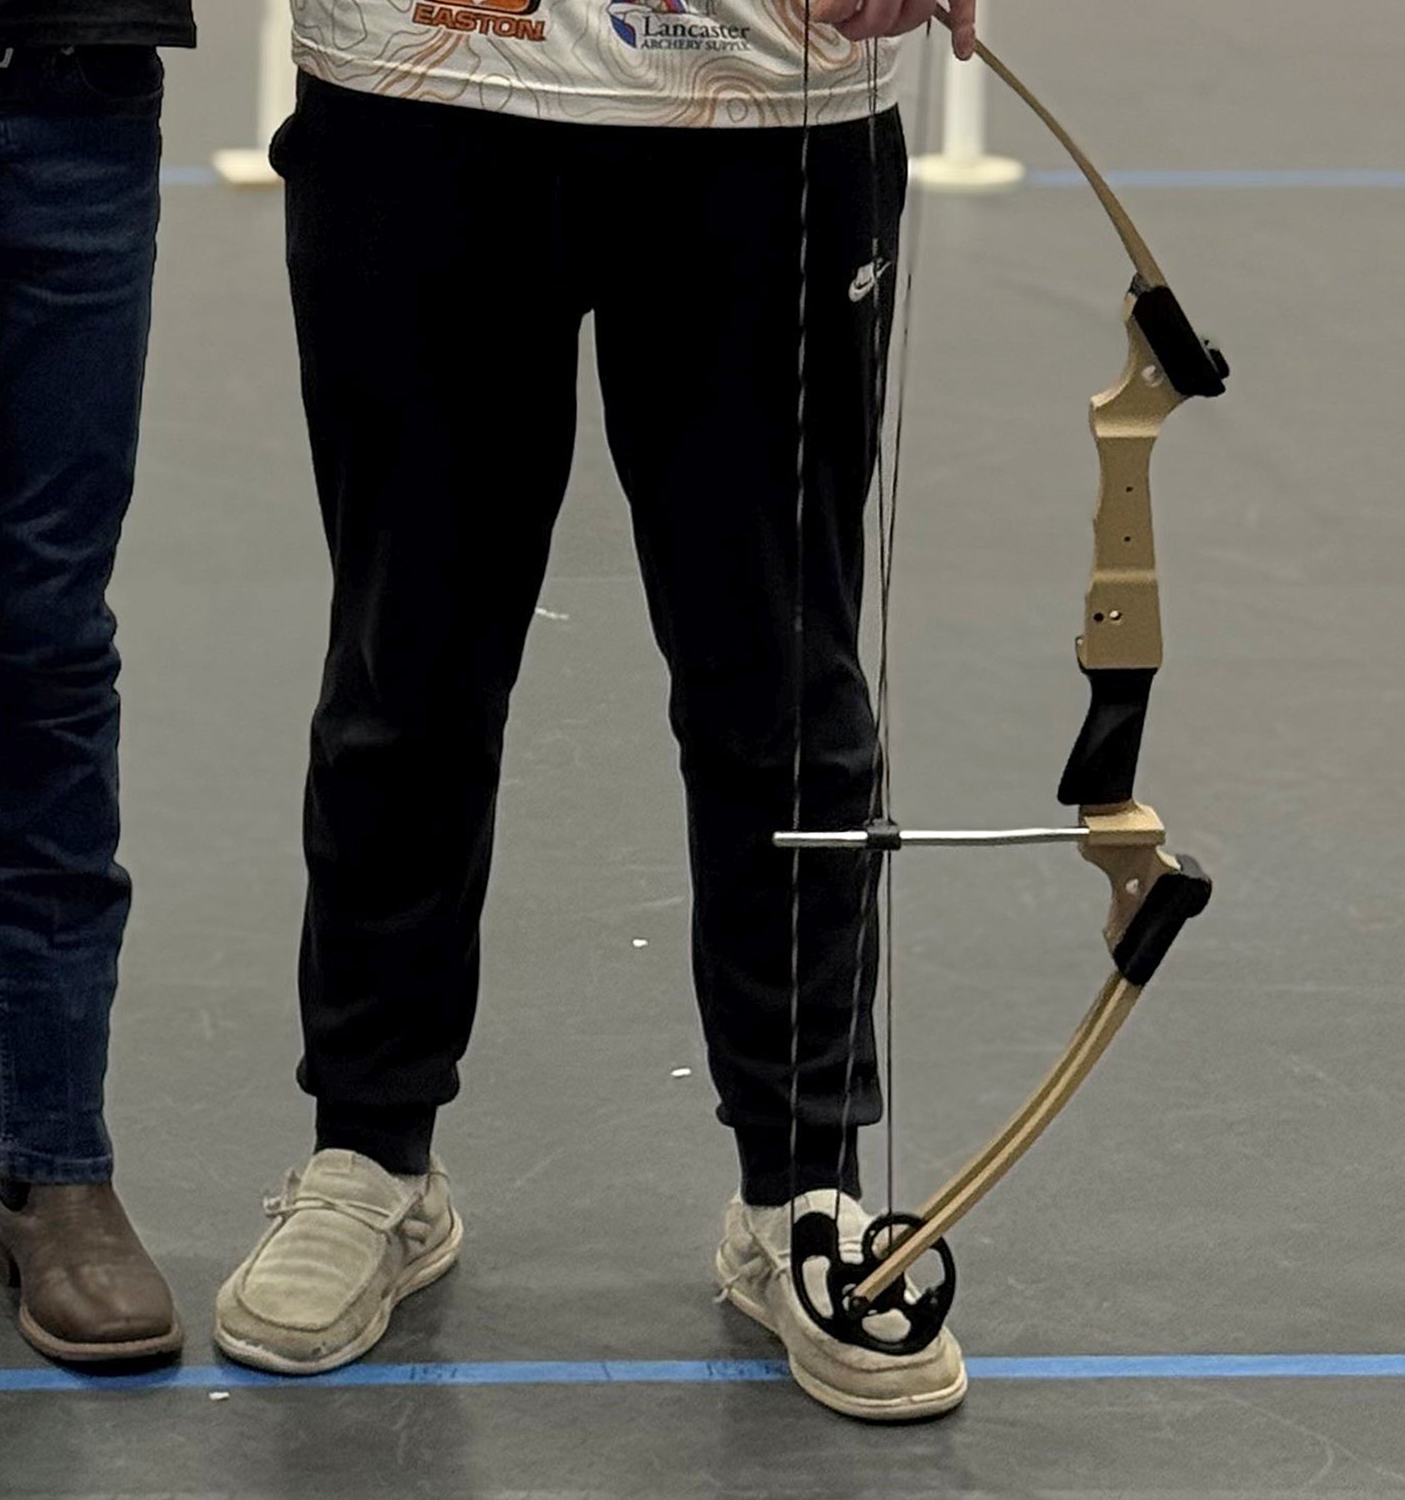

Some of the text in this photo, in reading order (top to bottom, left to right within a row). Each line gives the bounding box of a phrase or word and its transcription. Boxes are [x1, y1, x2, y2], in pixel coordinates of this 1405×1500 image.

[412, 3, 545, 41] EASTON
[643, 15, 751, 40] Lancaster
[640, 38, 704, 51] ARCHERY
